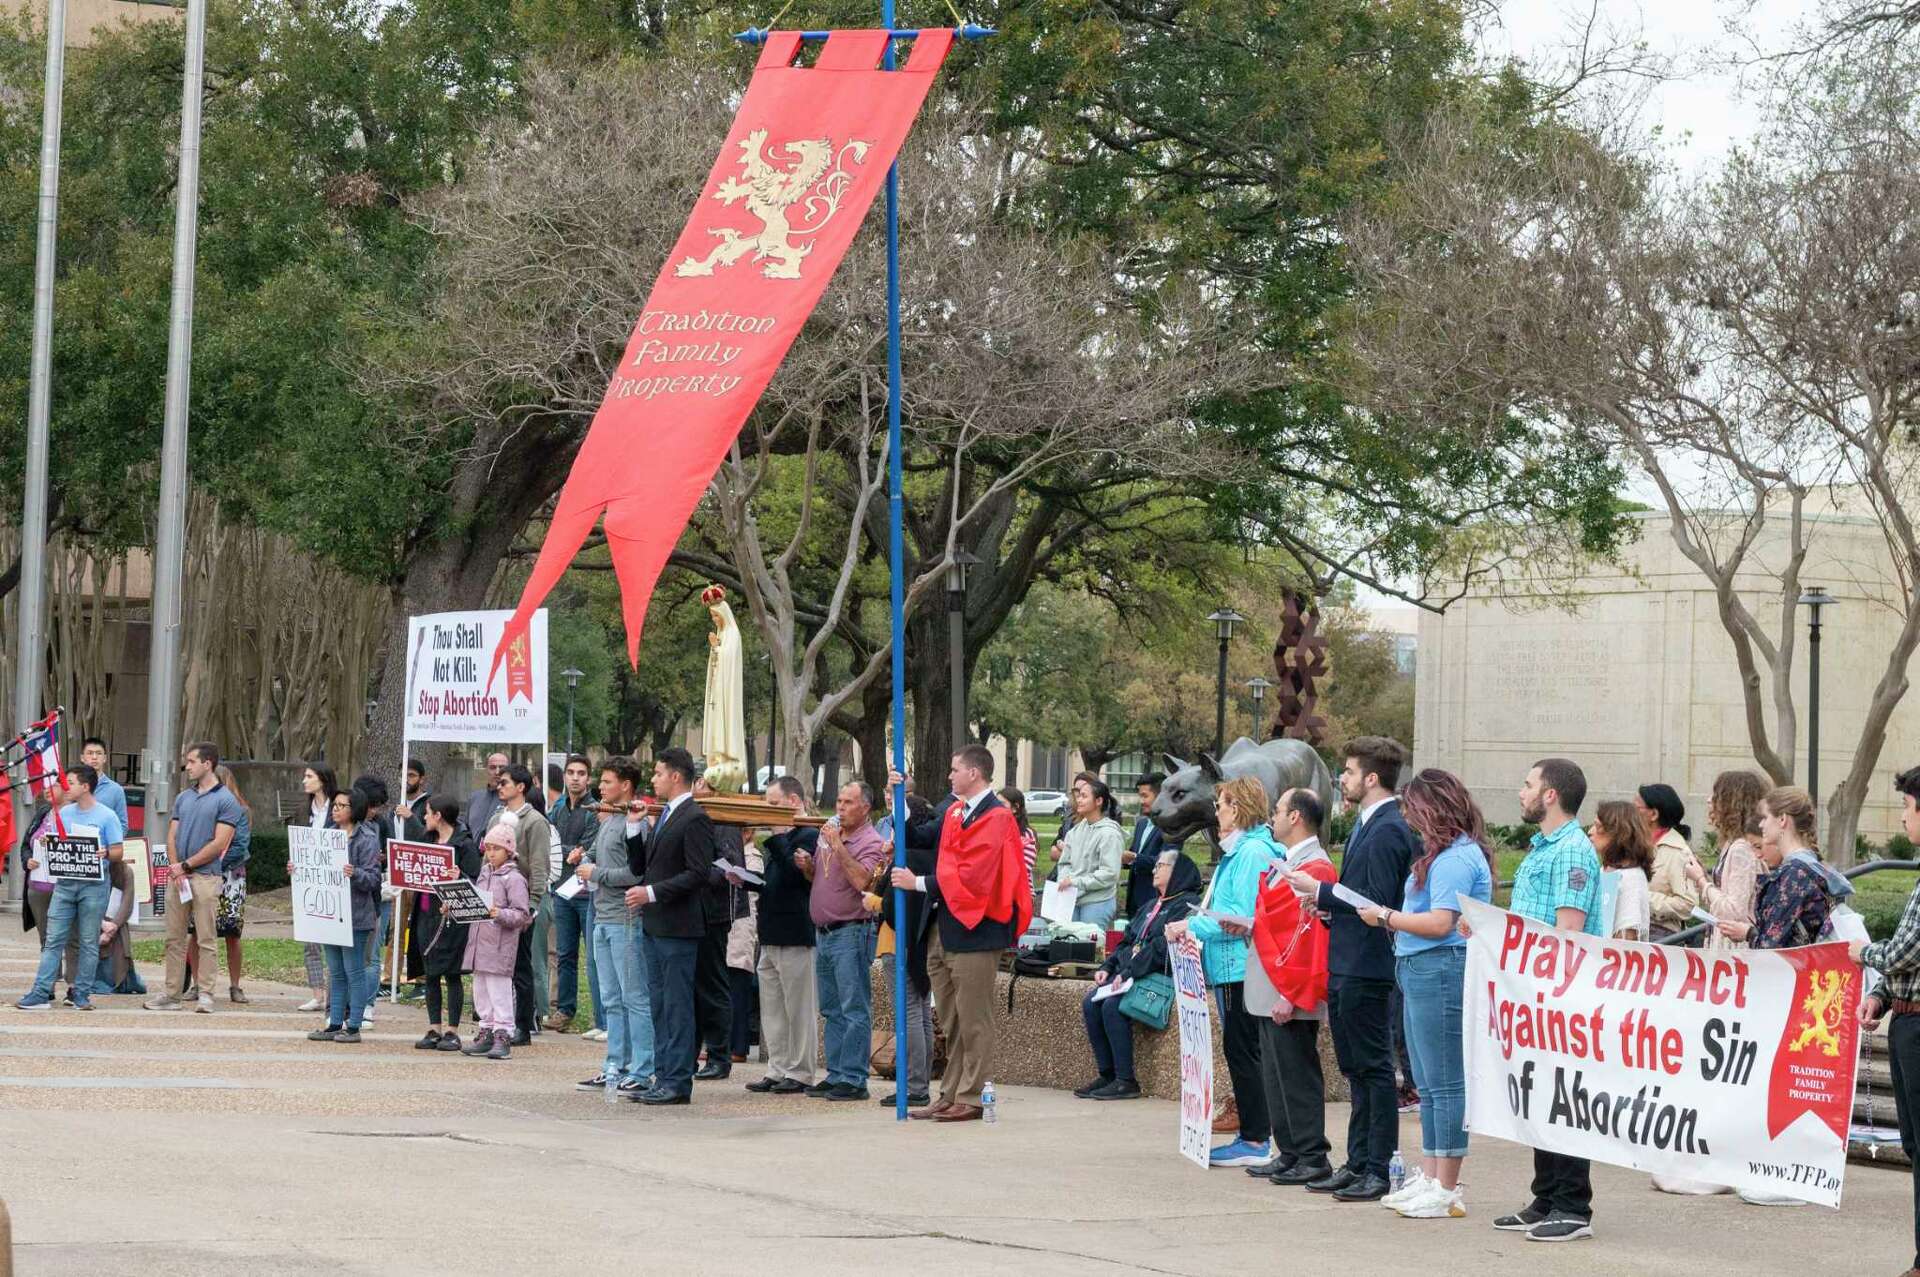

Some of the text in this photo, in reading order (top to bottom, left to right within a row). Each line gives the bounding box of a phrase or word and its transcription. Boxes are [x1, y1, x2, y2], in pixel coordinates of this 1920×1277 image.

[632, 339, 743, 366] Family
[432, 622, 483, 650] Thou Shall
[432, 656, 477, 682] Not Kill:
[418, 689, 499, 721] Stop Abortion
[319, 830, 330, 847] IS
[49, 842, 95, 853] I AM THE
[48, 851, 99, 864] PRO-LIFE
[314, 848, 333, 866] ONE
[397, 851, 414, 860] LET
[417, 853, 445, 865] THEIR
[50, 862, 99, 873] GENERATION
[293, 867, 324, 885] STATE
[394, 859, 449, 877] HEARTS
[404, 872, 439, 886] BEAT
[444, 890, 459, 898] AM
[457, 889, 475, 897] THE
[1500, 913, 1749, 1009] Pray and Act
[1487, 980, 1758, 1086] Against the Sin
[1789, 1064, 1835, 1079] TRADITION
[1795, 1077, 1826, 1091] FAMILY
[1789, 1088, 1833, 1103] PROPERTY
[1508, 1060, 1711, 1156] of Abortion.
